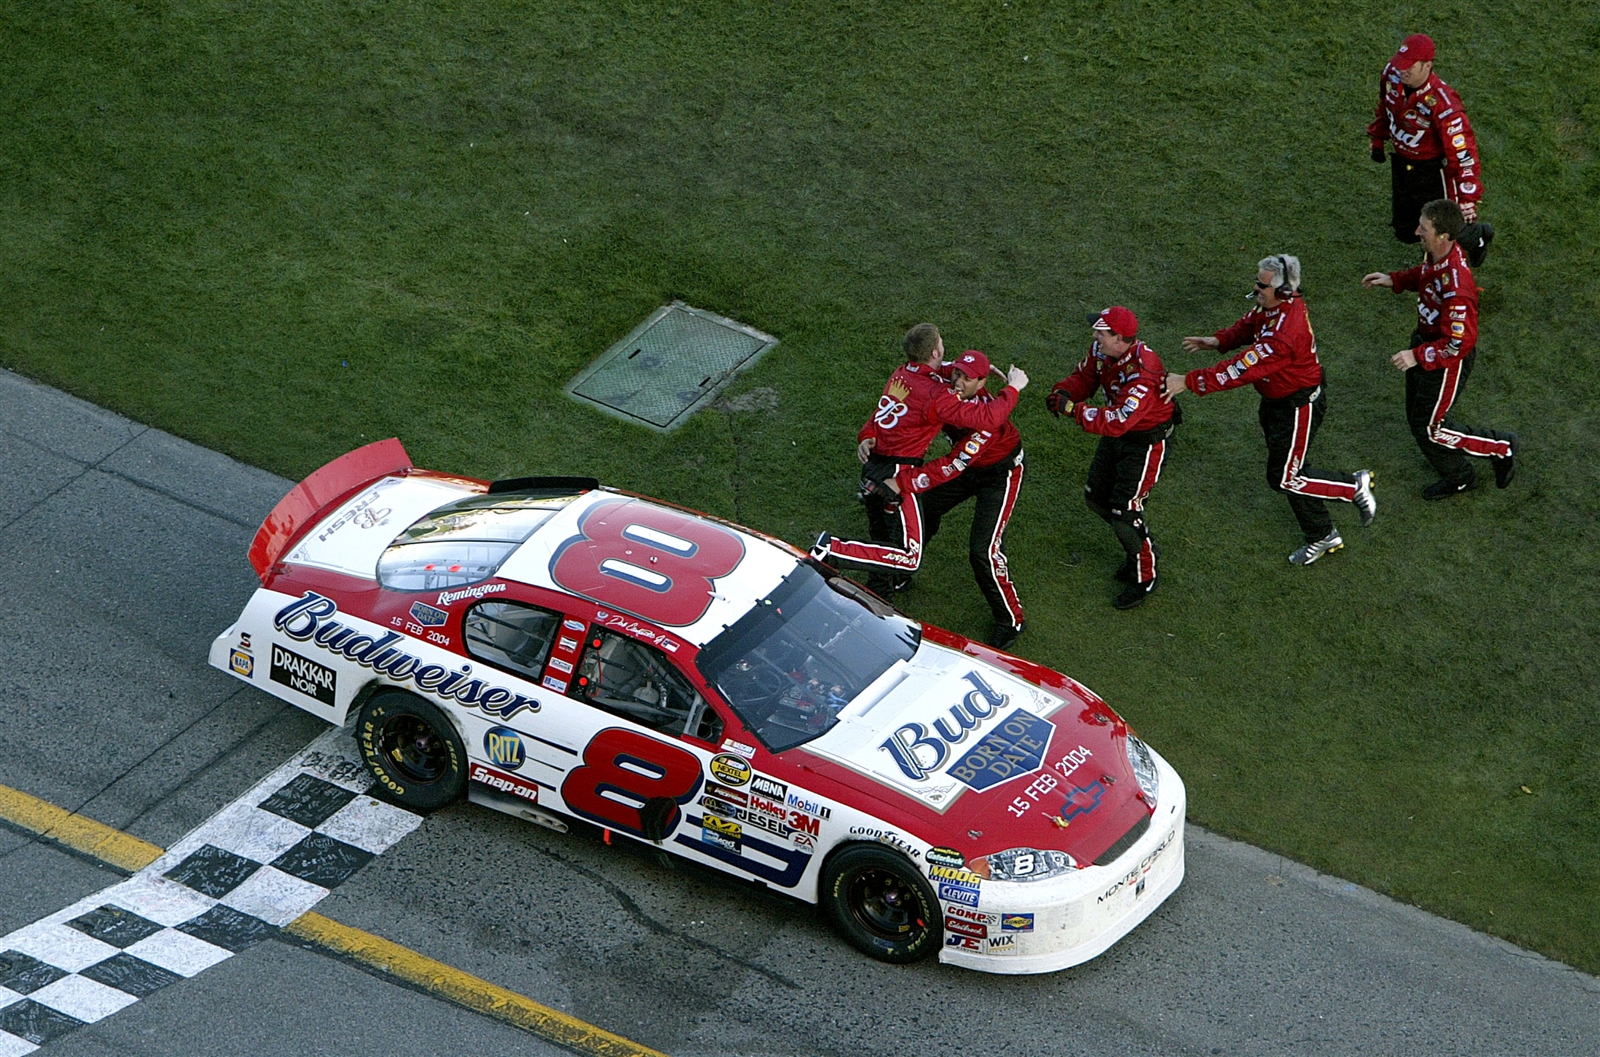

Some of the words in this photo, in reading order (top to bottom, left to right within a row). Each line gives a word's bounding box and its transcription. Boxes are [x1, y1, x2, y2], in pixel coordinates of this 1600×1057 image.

[1447, 123, 1463, 135] Bud
[318, 491, 381, 542] FRESH
[549, 498, 746, 627] 8
[436, 583, 507, 606] Remington
[413, 603, 434, 618] BORN
[434, 610, 447, 621] ON
[416, 612, 437, 625] DATE
[390, 616, 403, 626] 15
[405, 621, 424, 636] FEB
[427, 630, 450, 646] 2004
[235, 656, 250, 670] NAPA
[273, 591, 541, 720] Budweiser
[274, 647, 334, 691] DRAKKAR
[290, 674, 317, 696] NOIR
[877, 669, 1010, 782] Bud
[363, 721, 404, 795] GOODYEAR
[488, 732, 520, 763] RITZ
[952, 733, 1009, 784] BORN
[1004, 710, 1038, 739] ON
[988, 735, 1044, 779] DATE
[717, 764, 742, 778] NEXTEL
[1007, 796, 1031, 818] 15
[1025, 772, 1059, 802] FEB
[1054, 745, 1093, 778] 2004
[471, 767, 537, 800] Snap-on
[561, 726, 704, 840] 8
[751, 777, 785, 799] MBNA
[750, 795, 787, 820] Holley
[787, 793, 819, 813] Mobil
[737, 809, 788, 837] JESEL
[788, 810, 820, 836] 3M
[793, 842, 814, 854] SPORTS
[795, 833, 814, 848] EA
[849, 826, 921, 858] GOODYEAR
[926, 851, 964, 865] Gatorback
[1014, 854, 1034, 875] 8
[1097, 865, 1140, 905] MONTE
[1140, 829, 1175, 868] CARLO
[930, 865, 982, 884] MOOG
[941, 885, 976, 902] CLEVITE
[947, 906, 987, 921] COMP
[1003, 918, 1032, 926] SUNOCO
[948, 920, 982, 935] Edelbrock
[946, 934, 980, 950] JE
[989, 934, 1014, 948] WIX
